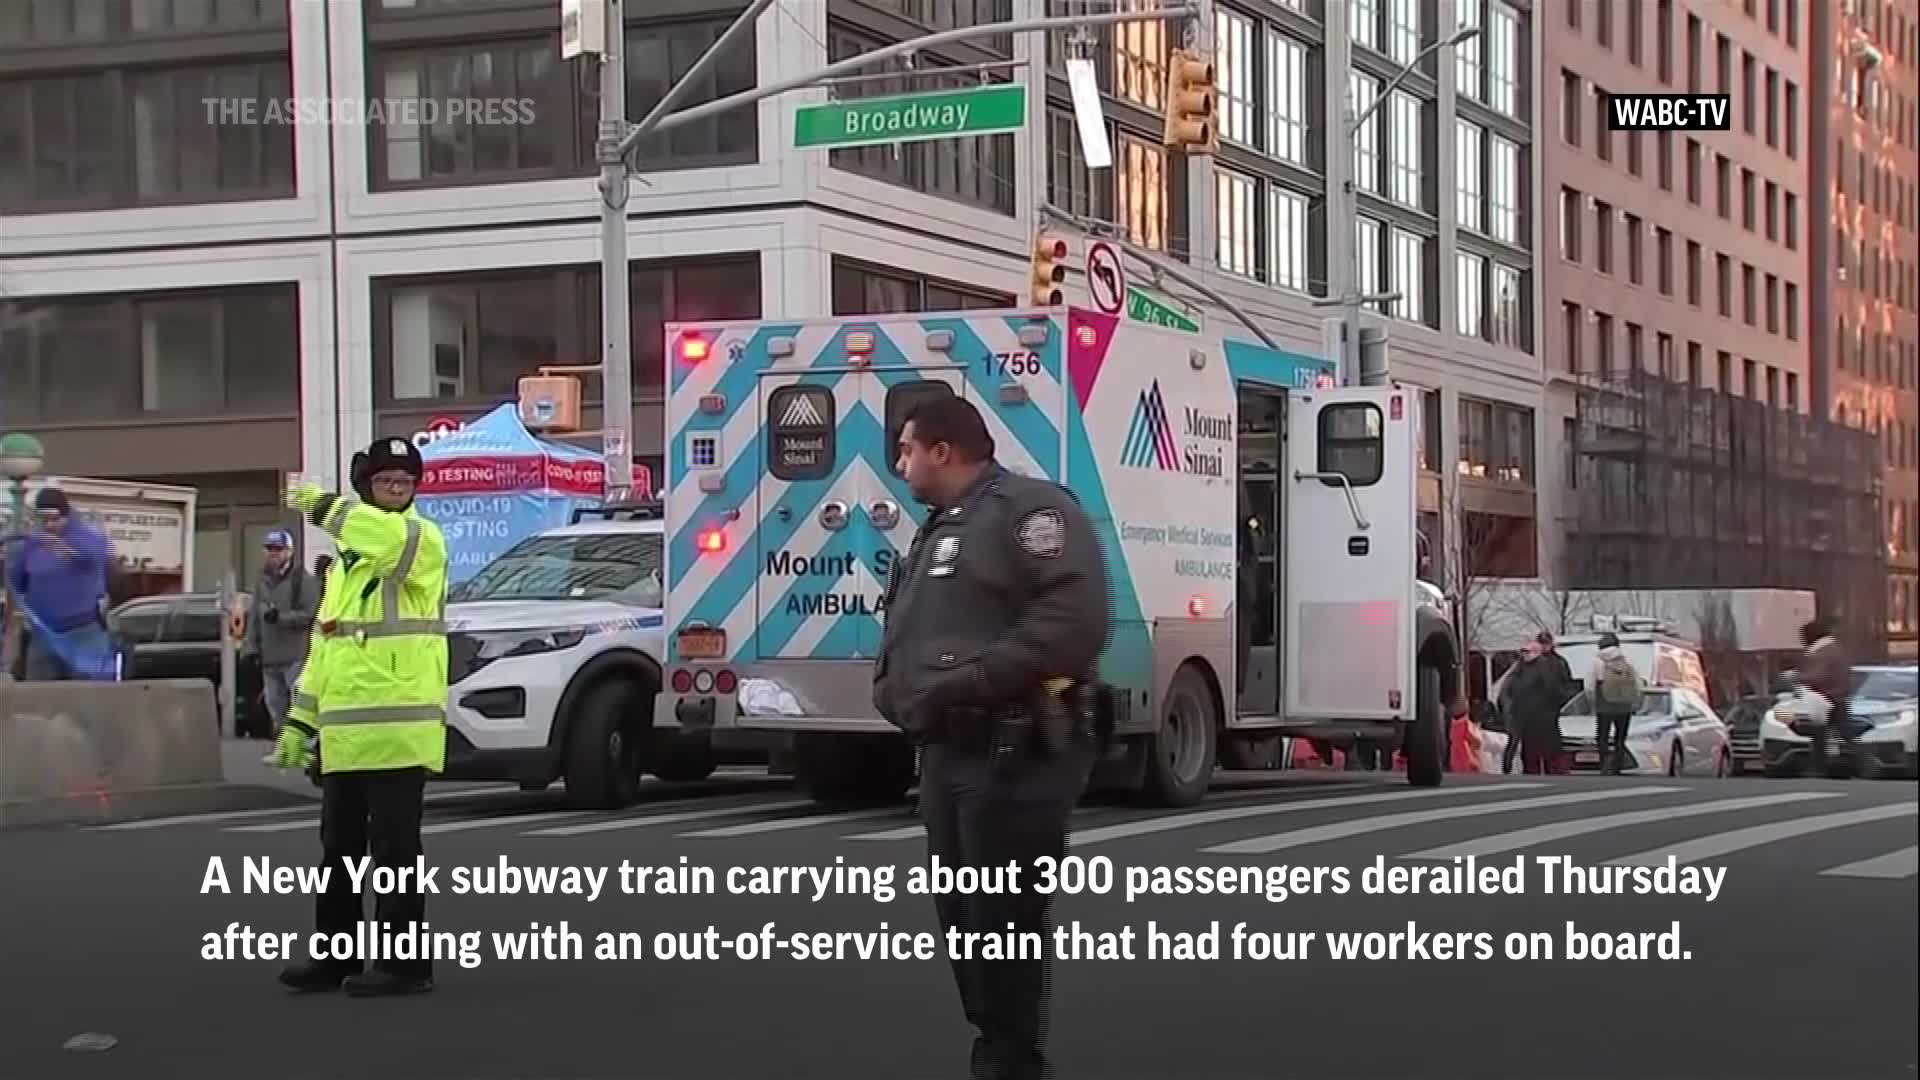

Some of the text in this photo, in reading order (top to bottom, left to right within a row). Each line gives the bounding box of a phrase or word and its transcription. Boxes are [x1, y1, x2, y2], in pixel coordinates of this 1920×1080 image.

[845, 103, 969, 134] Broadway
[1143, 302, 1160, 324] 96
[982, 352, 1041, 376] 1756
[1184, 406, 1233, 441] Mount
[784, 437, 824, 450] Mount
[784, 451, 815, 465] Sinai
[1184, 444, 1223, 477] Sinai
[437, 467, 494, 483] TESTING
[426, 498, 512, 514] COVID-19
[444, 520, 510, 537] ESTING
[1121, 521, 1232, 547] Emergency Medical Services
[766, 551, 855, 576] Mount
[1174, 560, 1233, 579] AMBULANCE
